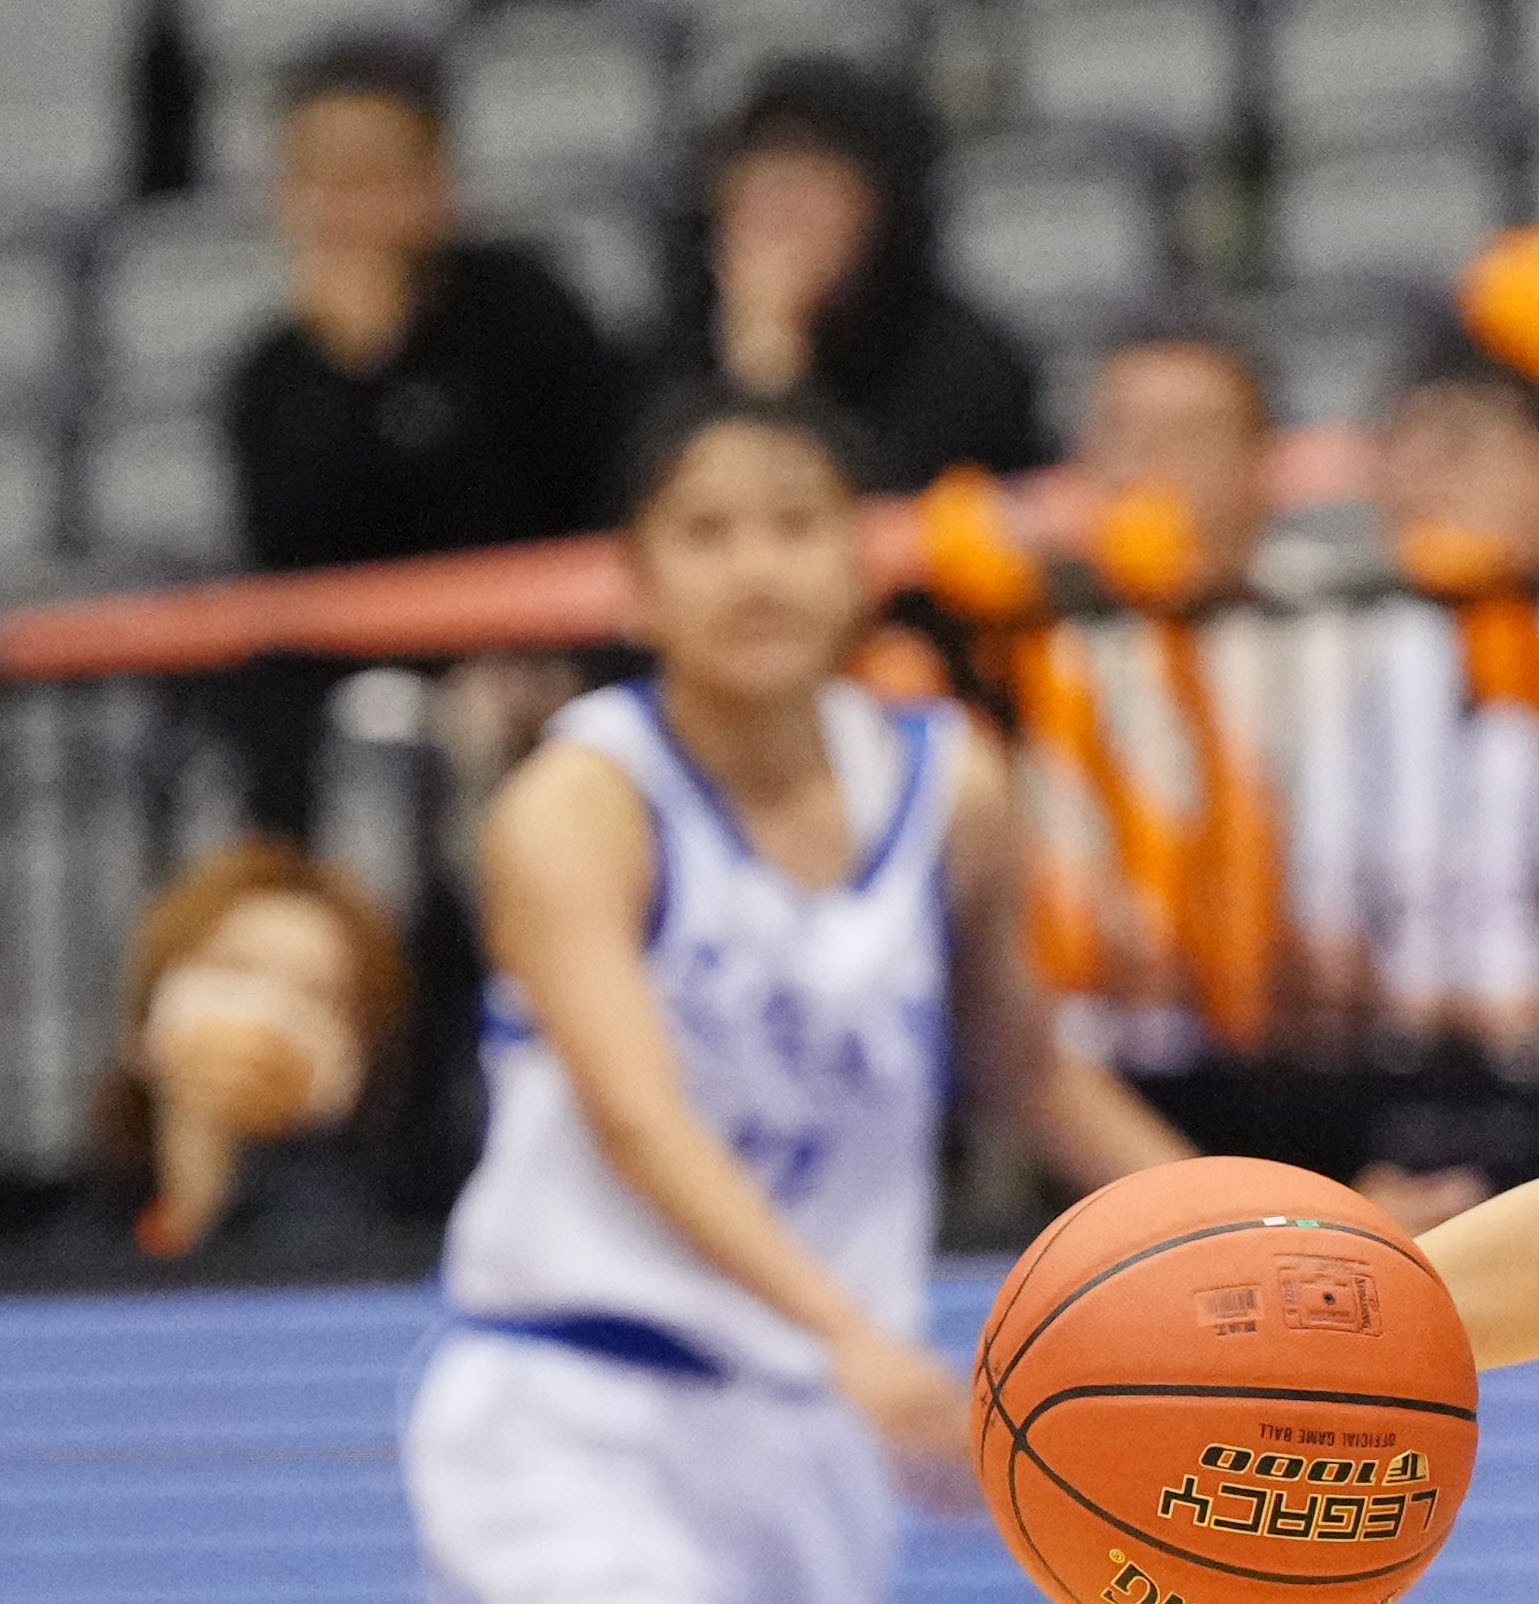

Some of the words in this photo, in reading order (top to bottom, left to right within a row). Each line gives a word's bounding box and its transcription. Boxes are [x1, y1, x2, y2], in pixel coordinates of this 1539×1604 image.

[1258, 1423, 1293, 1446] BALL
[1298, 1428, 1336, 1447] GAME
[1341, 1431, 1396, 1449] OFFICIAL
[1157, 1474, 1440, 1543] LEGACY
